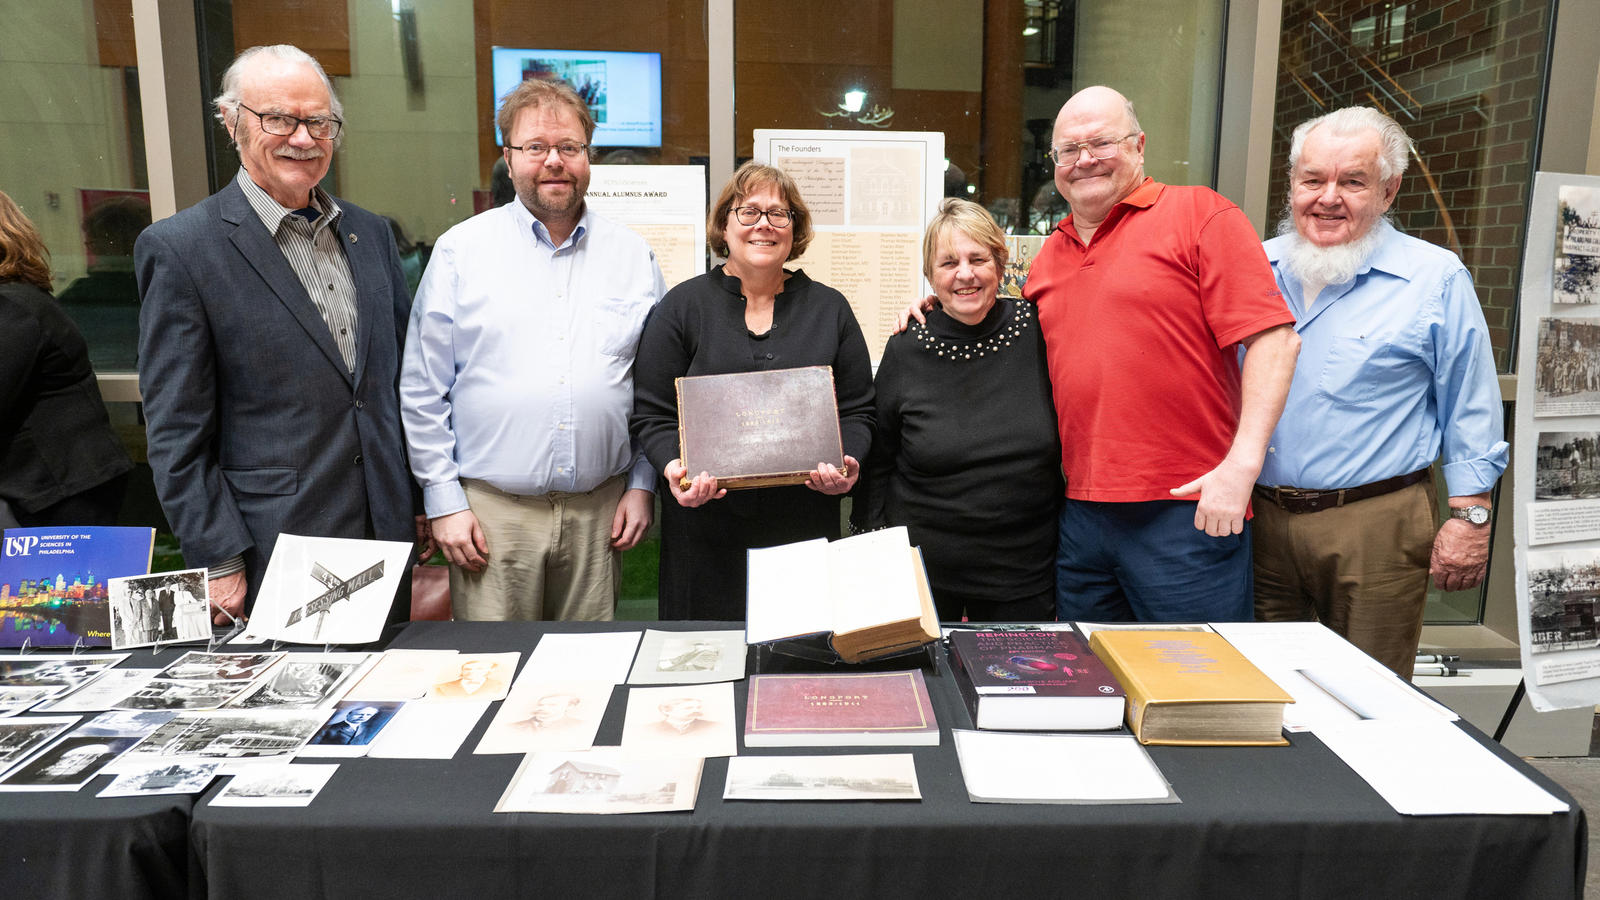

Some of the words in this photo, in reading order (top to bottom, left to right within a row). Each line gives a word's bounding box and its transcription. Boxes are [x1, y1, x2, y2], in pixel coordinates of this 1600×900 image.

[4, 536, 39, 557] USP
[347, 570, 375, 593] MALL
[87, 630, 111, 638] Where
